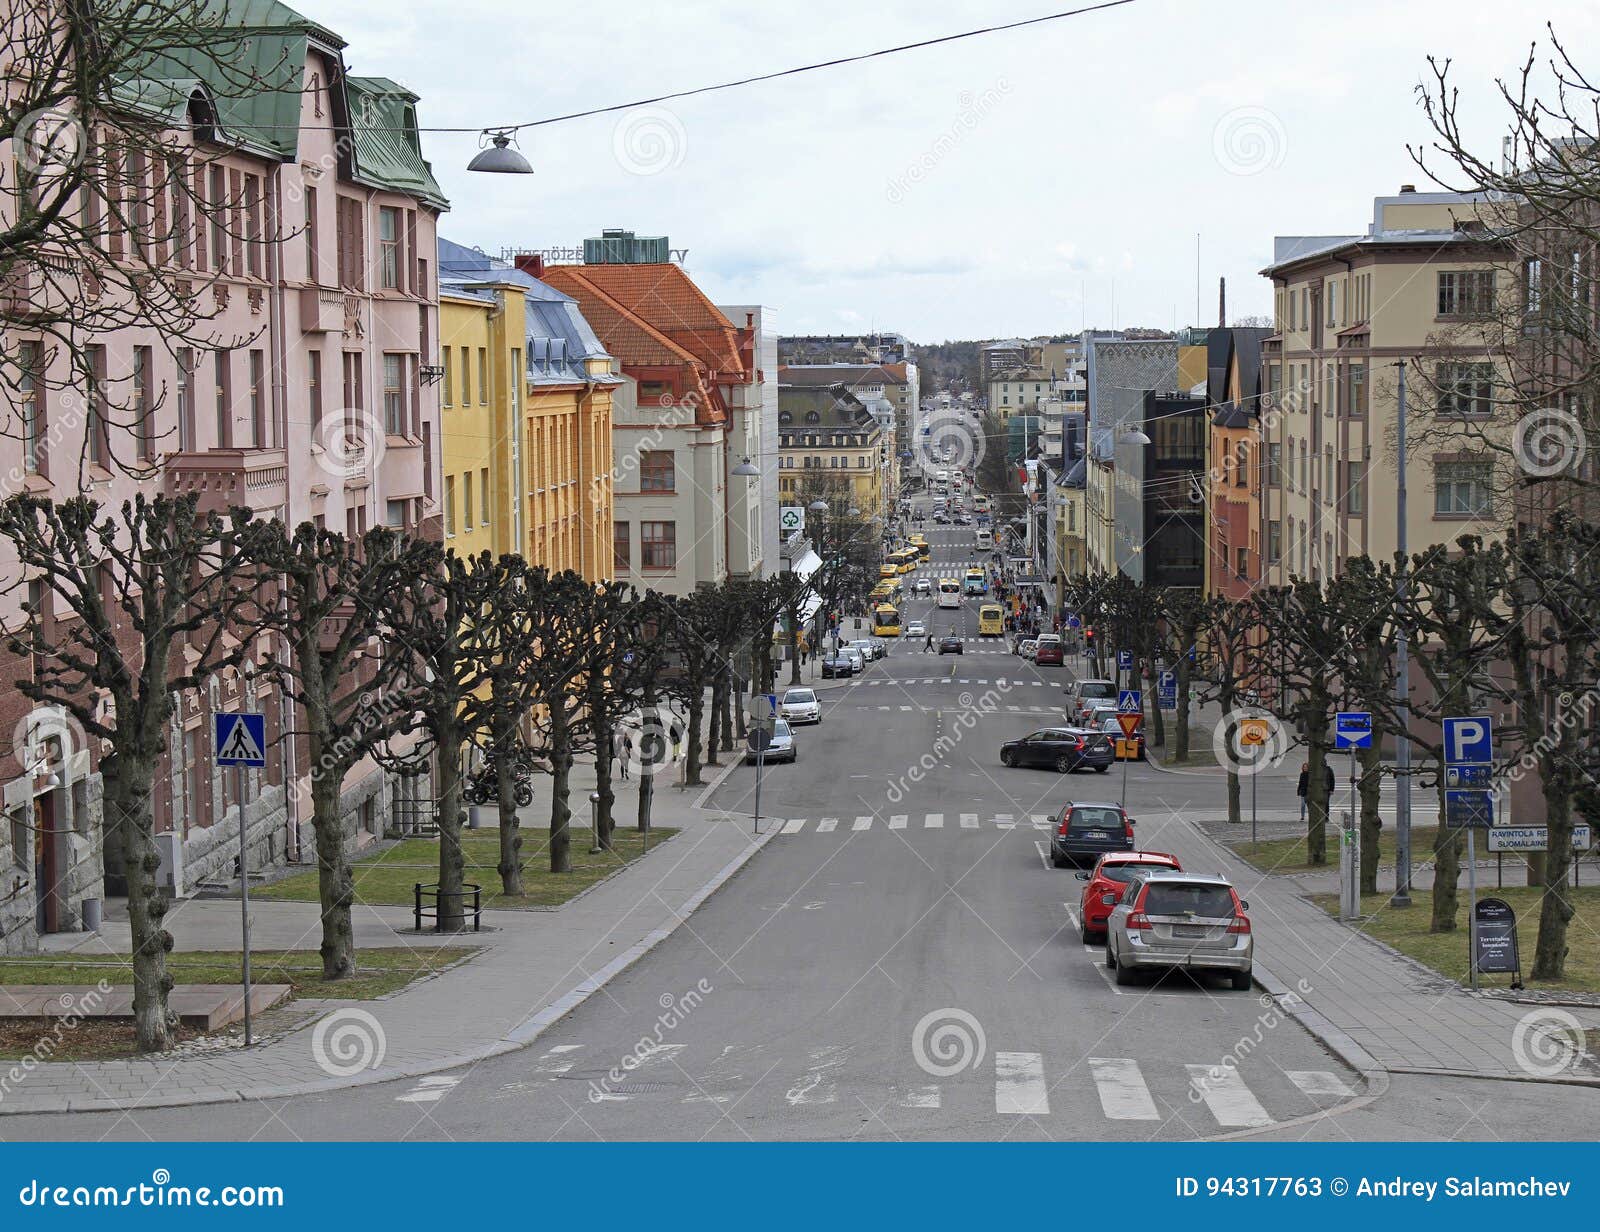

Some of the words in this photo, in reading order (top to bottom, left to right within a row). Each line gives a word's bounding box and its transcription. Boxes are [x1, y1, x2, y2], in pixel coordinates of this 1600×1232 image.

[1162, 671, 1174, 687] P
[1453, 721, 1484, 760] P
[1497, 840, 1548, 848] SUOMALAINE
